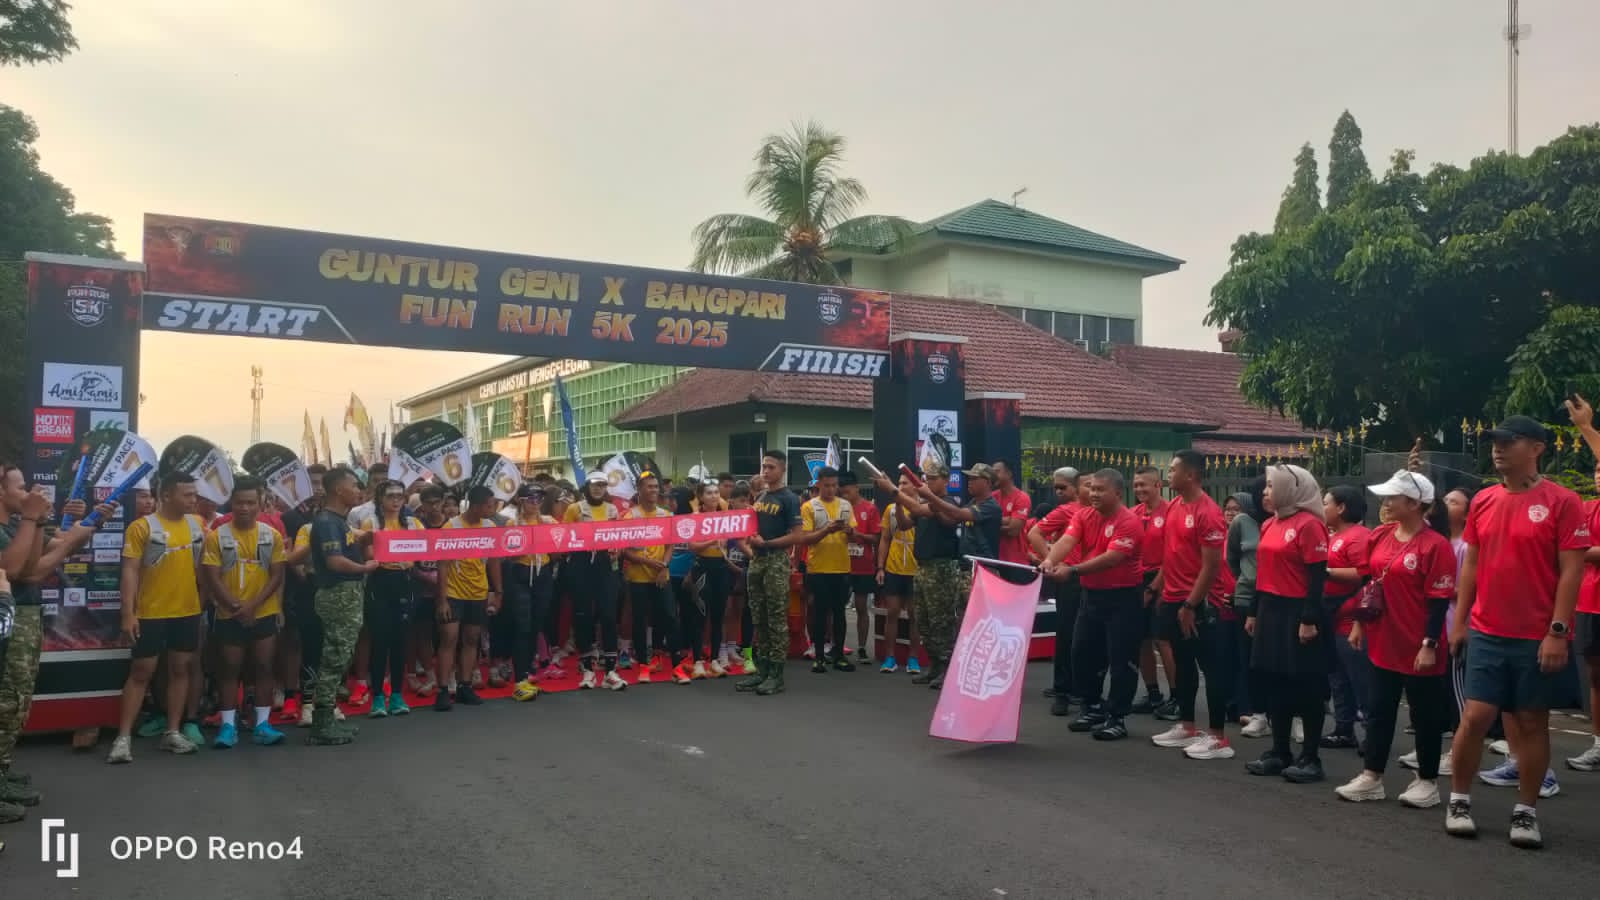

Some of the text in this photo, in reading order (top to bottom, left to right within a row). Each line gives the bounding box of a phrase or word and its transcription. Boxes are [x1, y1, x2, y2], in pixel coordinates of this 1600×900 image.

[318, 248, 788, 321] GUNTUR GENI X BANGPARI
[74, 299, 100, 315] 5K
[157, 300, 321, 336] START
[400, 294, 730, 348] FUN RUN 5K 2025
[777, 349, 887, 378] FINISH
[35, 424, 72, 435] CREAM
[114, 437, 137, 465] PACE
[443, 452, 464, 480] 6
[203, 465, 230, 497] 7
[281, 474, 299, 501] 7
[495, 471, 517, 495] 6
[594, 529, 621, 542] FUN
[621, 527, 647, 541] RUN
[701, 514, 751, 536] START
[435, 541, 457, 551] FUN
[457, 540, 480, 549] RUN
